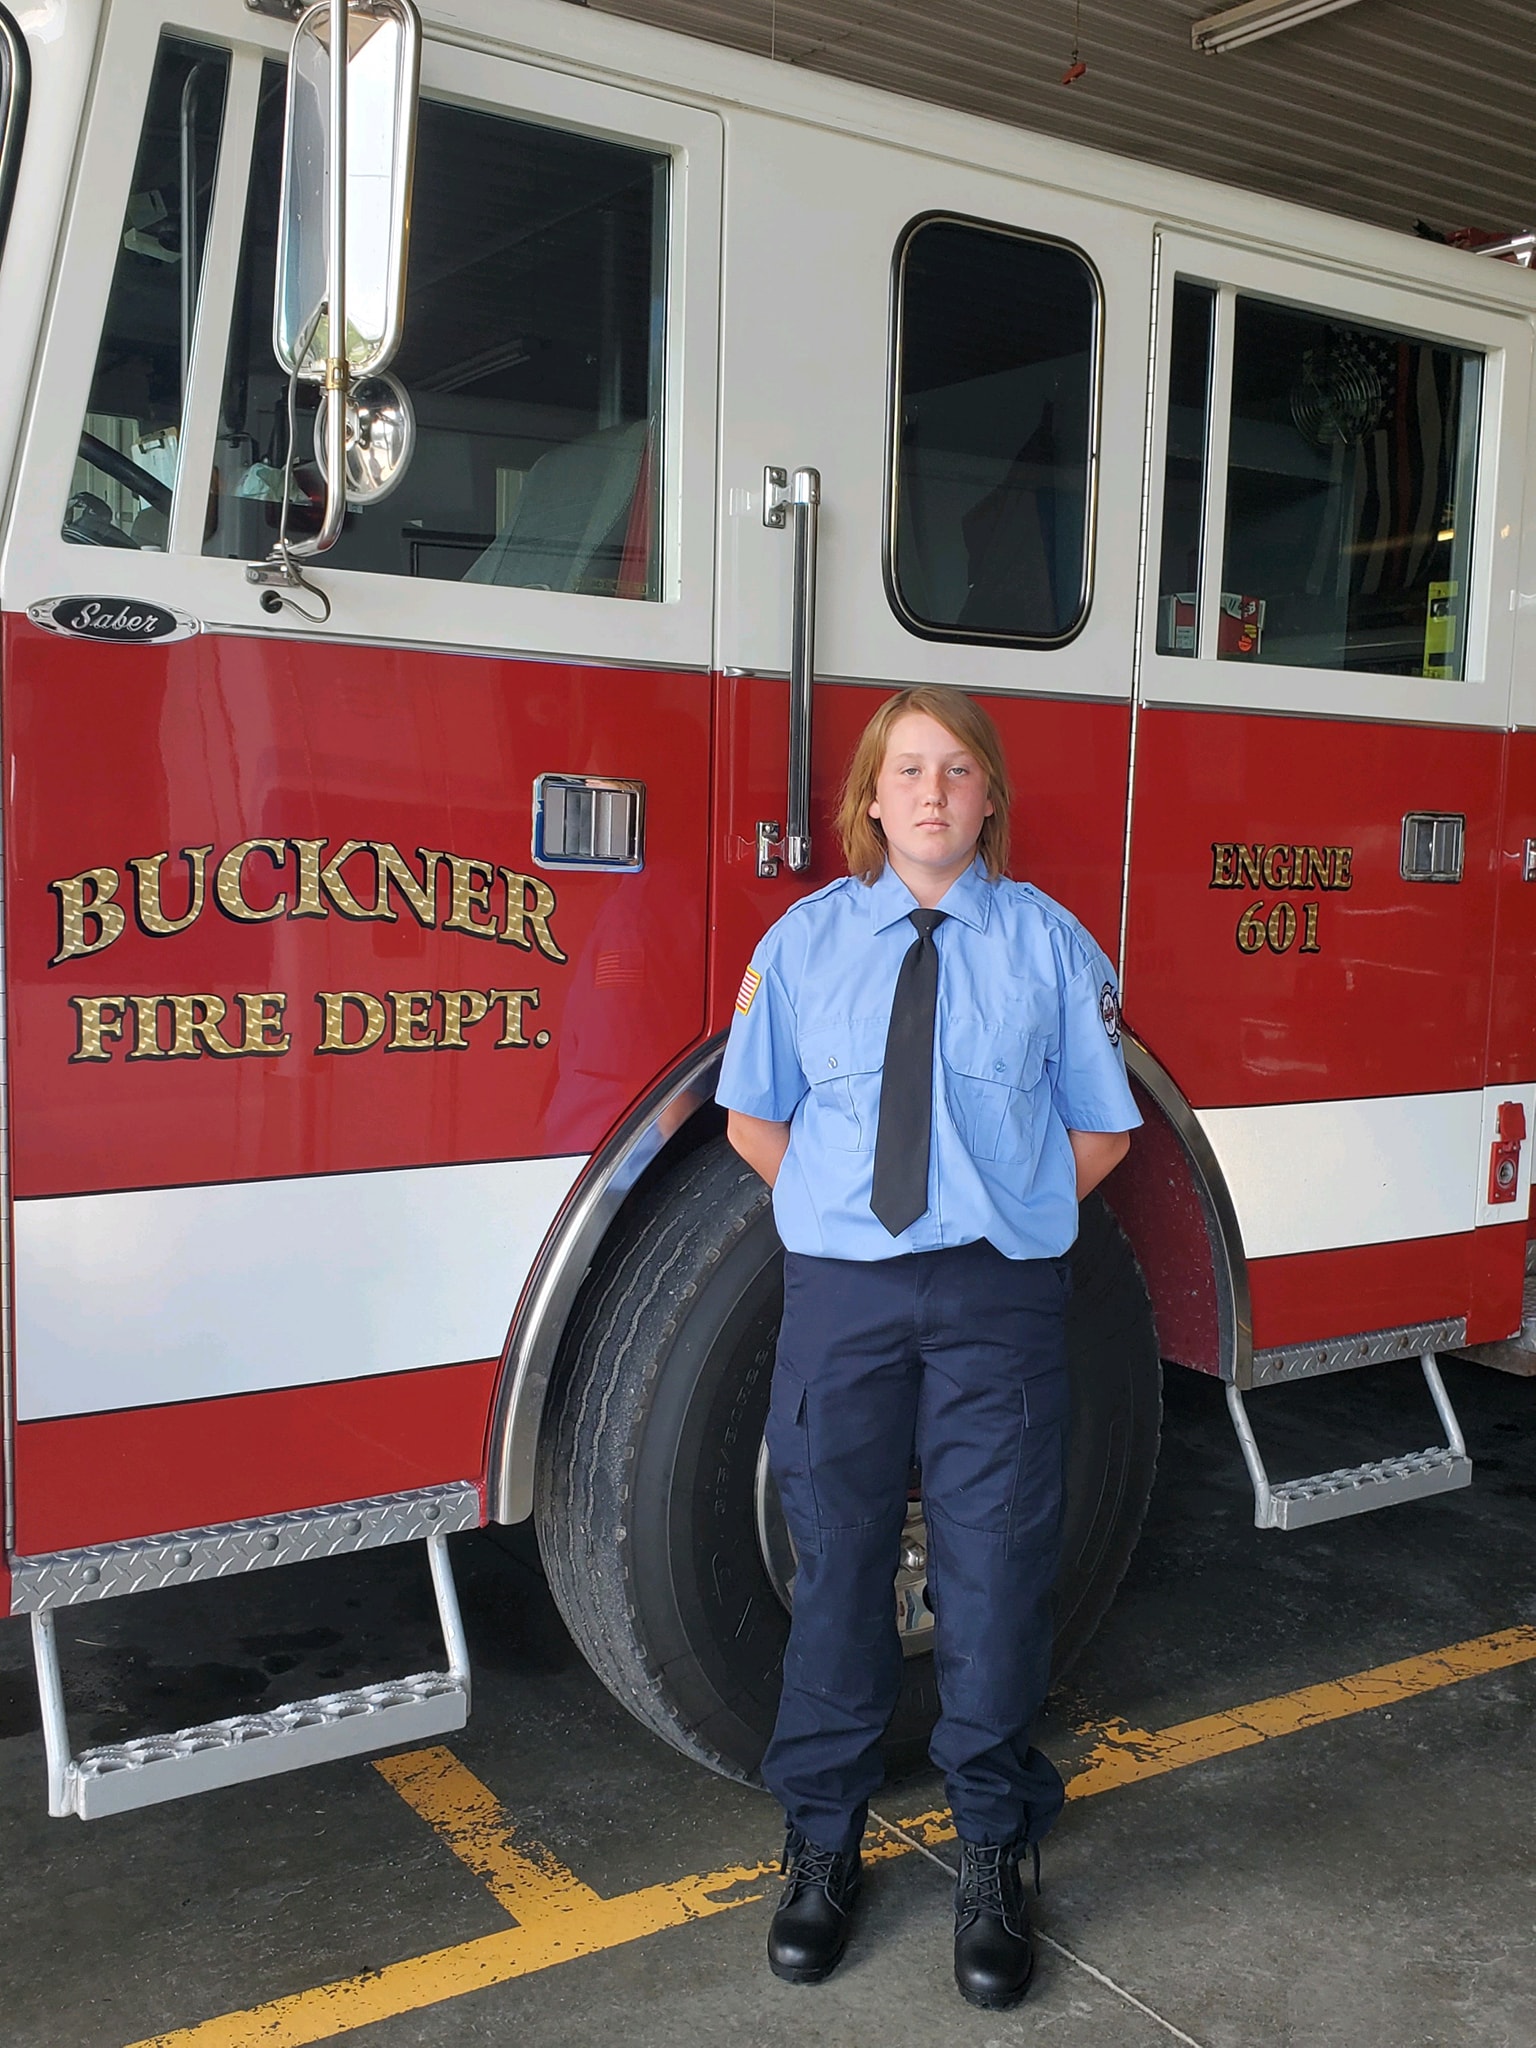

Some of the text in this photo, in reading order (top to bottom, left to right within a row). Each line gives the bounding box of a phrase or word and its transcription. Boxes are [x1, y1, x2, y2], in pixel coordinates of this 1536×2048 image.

[71, 603, 160, 633] Saber
[1208, 842, 1353, 891] ENGINE
[47, 838, 569, 968] BUCKNER
[1236, 901, 1321, 954] 601
[68, 988, 552, 1063] FIRE DEPT.
